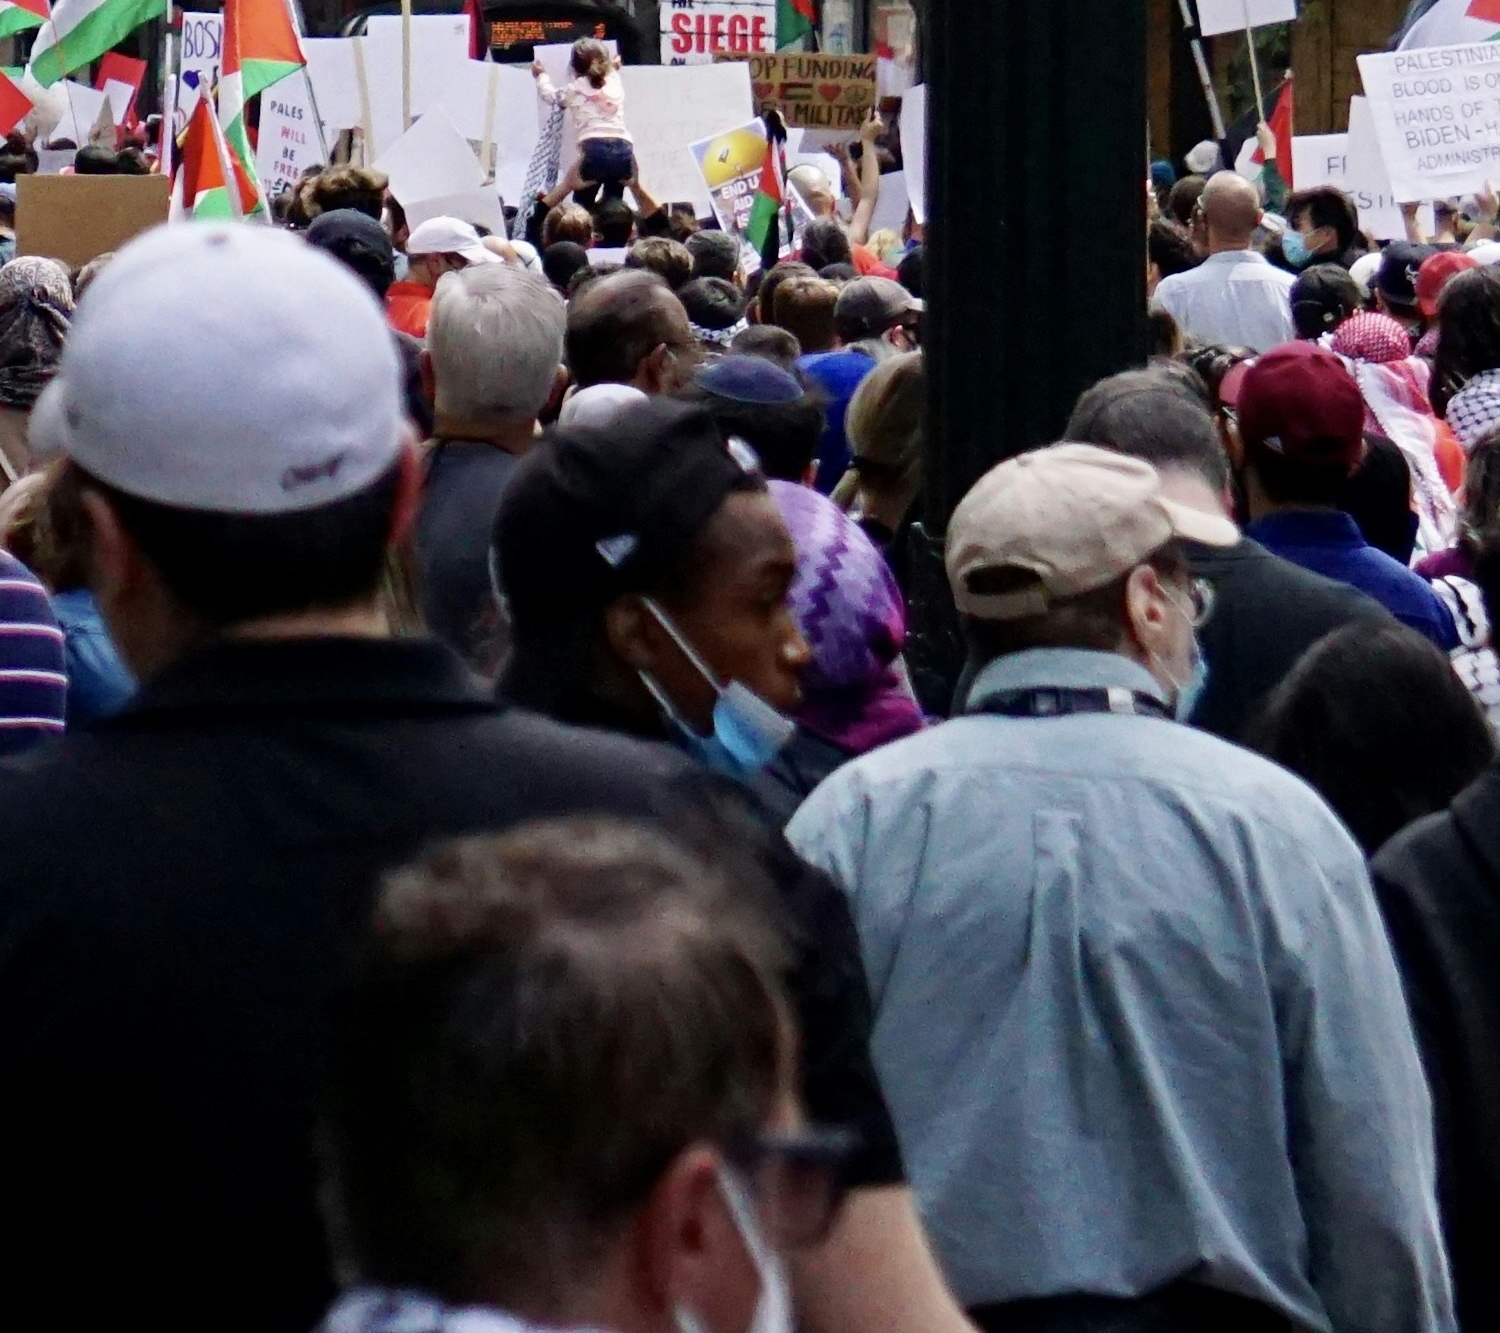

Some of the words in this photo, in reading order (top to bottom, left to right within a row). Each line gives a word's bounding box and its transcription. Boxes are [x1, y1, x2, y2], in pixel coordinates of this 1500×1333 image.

[670, 13, 767, 55] SIEGE
[783, 56, 876, 81] FUNDING
[1392, 78, 1453, 99] BLOOD
[1464, 75, 1481, 92] IS
[1394, 105, 1455, 127] HANDS
[1460, 101, 1484, 119] OF
[720, 179, 748, 200] END
